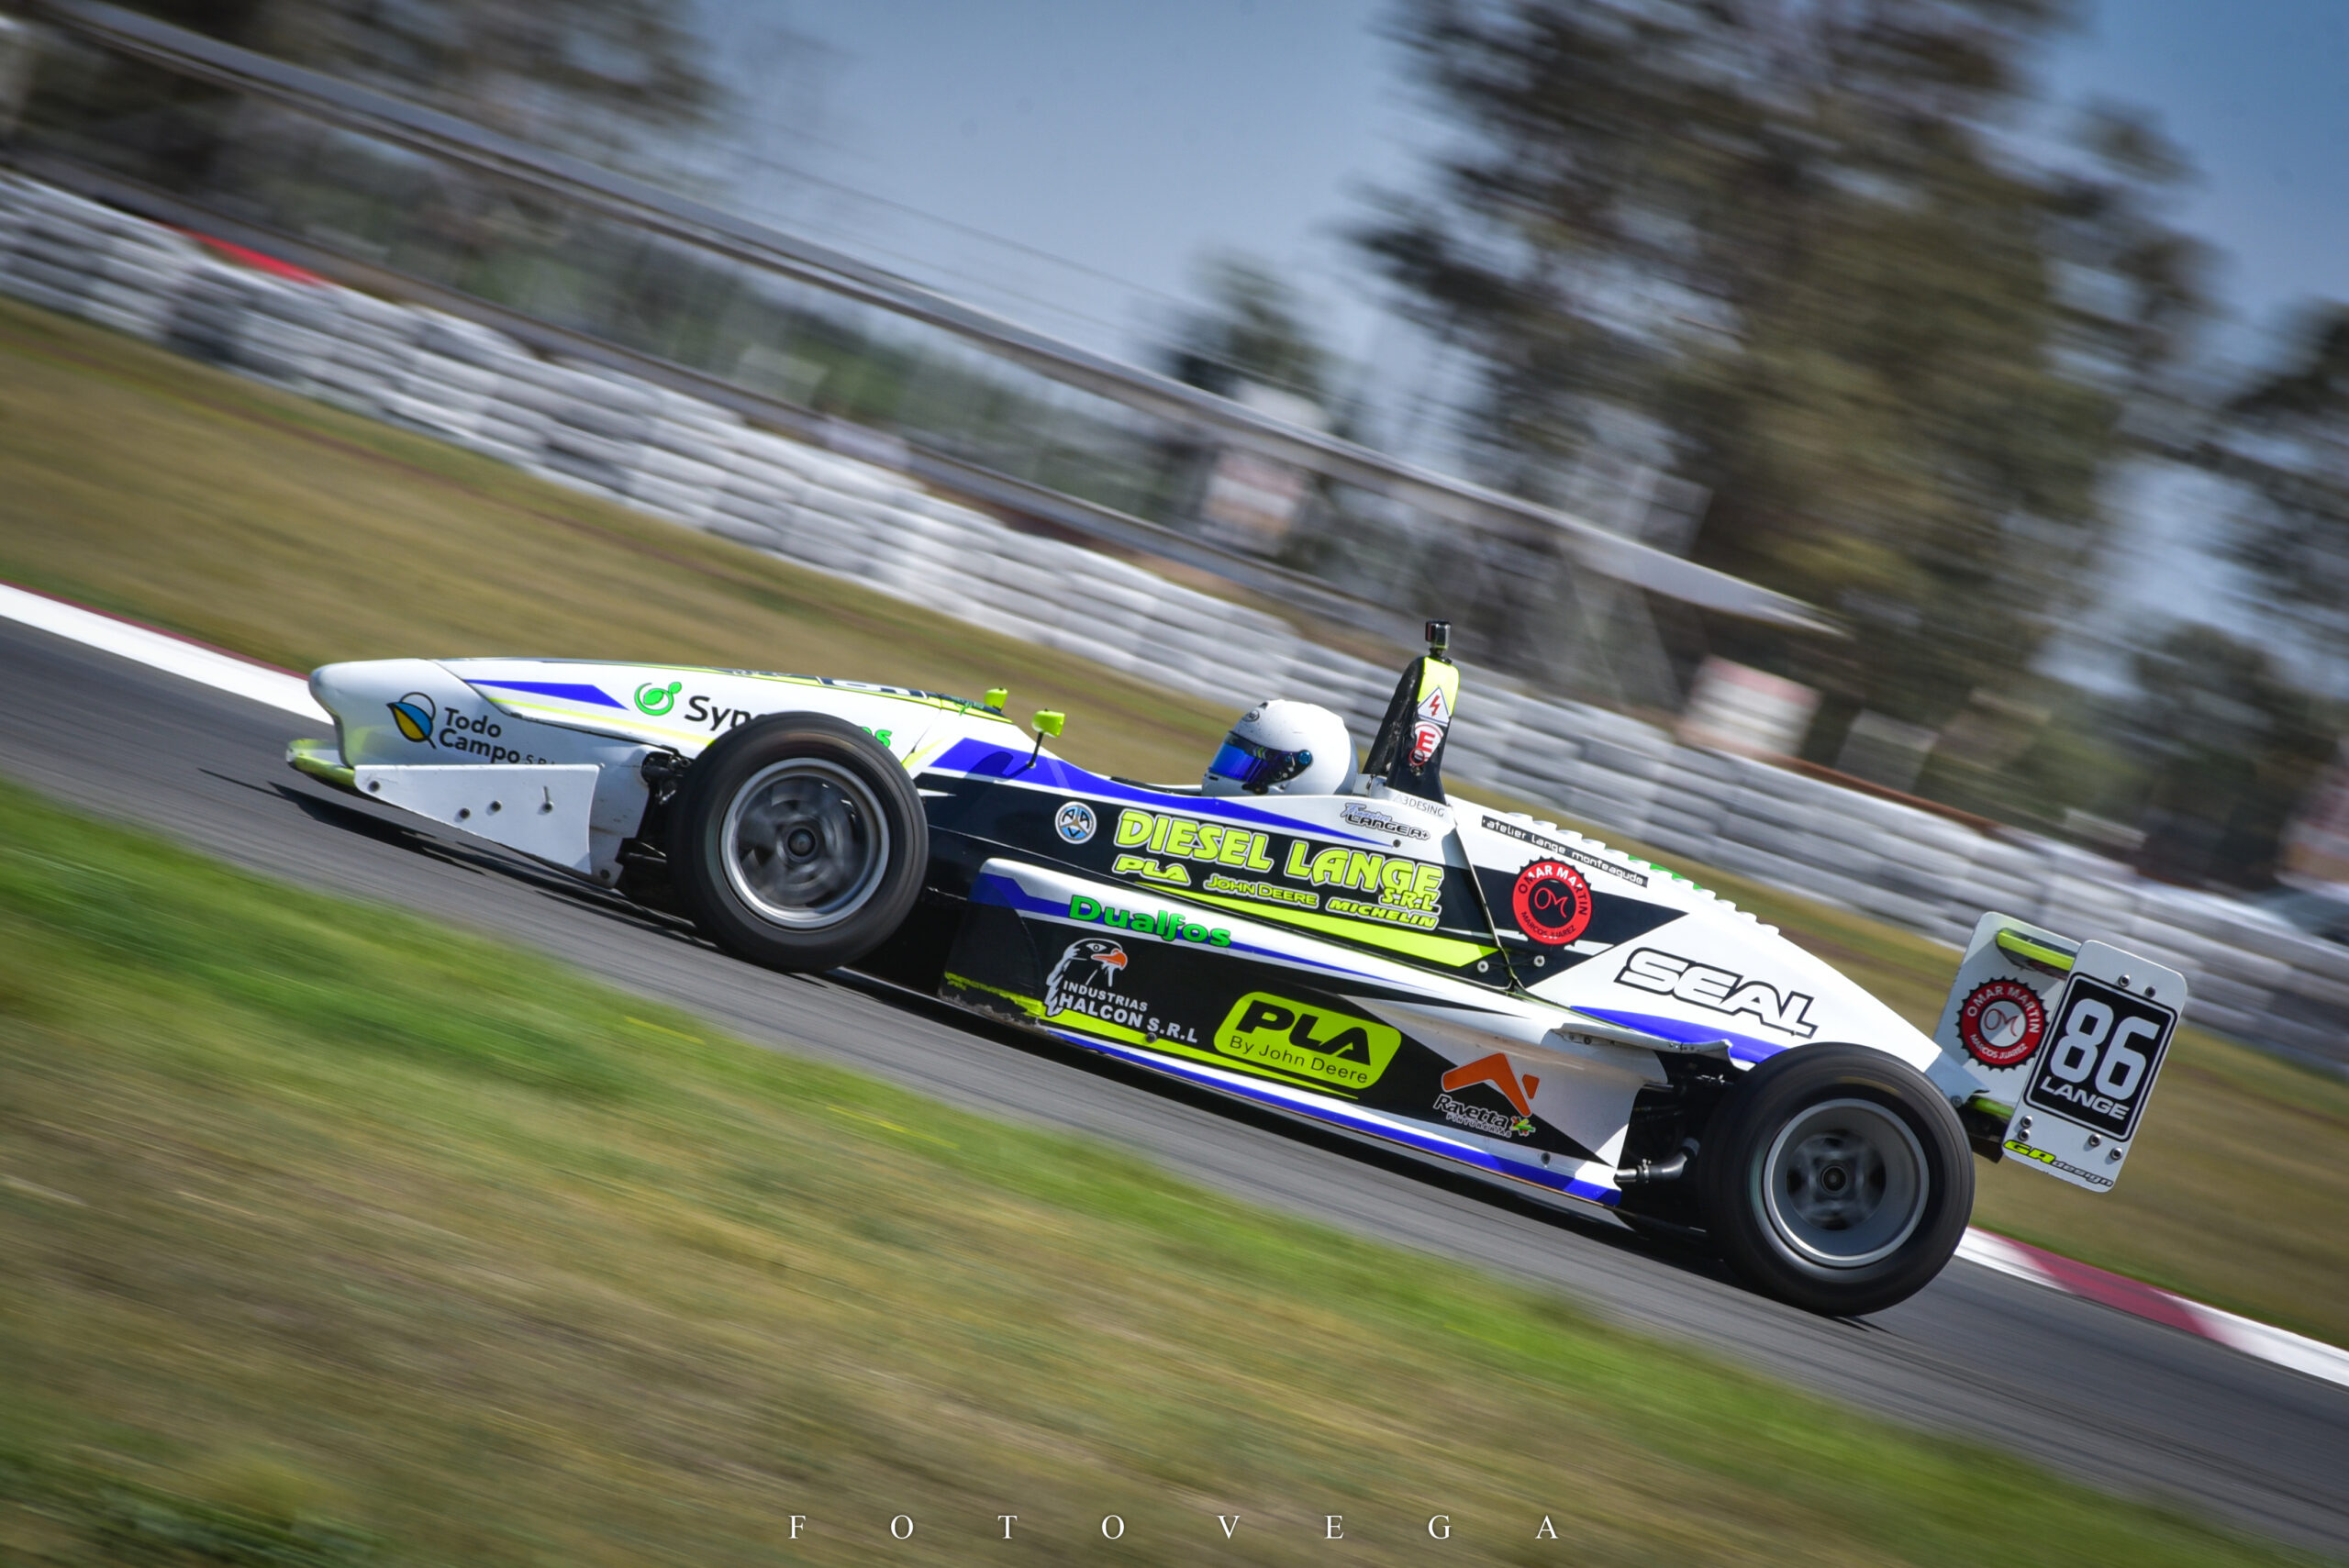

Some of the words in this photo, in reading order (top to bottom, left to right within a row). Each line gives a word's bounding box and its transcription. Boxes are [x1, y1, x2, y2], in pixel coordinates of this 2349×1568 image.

[439, 728, 520, 763] Campo
[445, 706, 502, 738] Todo
[1115, 809, 1274, 872] DIESEL
[1286, 840, 1443, 900] LANGE
[1486, 818, 1527, 840] atelier
[1531, 833, 1565, 854] lange
[1114, 855, 1190, 884] PLA
[1205, 874, 1256, 895] JOHN
[1257, 884, 1319, 906] DEERE
[1381, 886, 1435, 913] S.R.L
[1518, 865, 1553, 894] OMAR
[1556, 866, 1588, 916] MARTIN
[1068, 895, 1231, 948] Dualfos
[1328, 897, 1437, 929] MICHELIN
[1520, 911, 1548, 938] MARCOS
[1063, 981, 1148, 1012] INDUSTRIAS
[1613, 947, 1819, 1039] SEAL
[1967, 985, 2004, 1017] OMAR
[2008, 986, 2040, 1033] MARTIN
[1059, 993, 1142, 1028] HALCON
[1147, 1018, 1198, 1043] S.R.L
[1235, 999, 1371, 1066] PLA
[1230, 1035, 1254, 1054] By
[1259, 1044, 1305, 1066] John
[1311, 1057, 1368, 1084] Deere
[2050, 998, 2160, 1100] 86
[1433, 1094, 1509, 1129] Ravetta
[2039, 1076, 2131, 1121] LANGE
